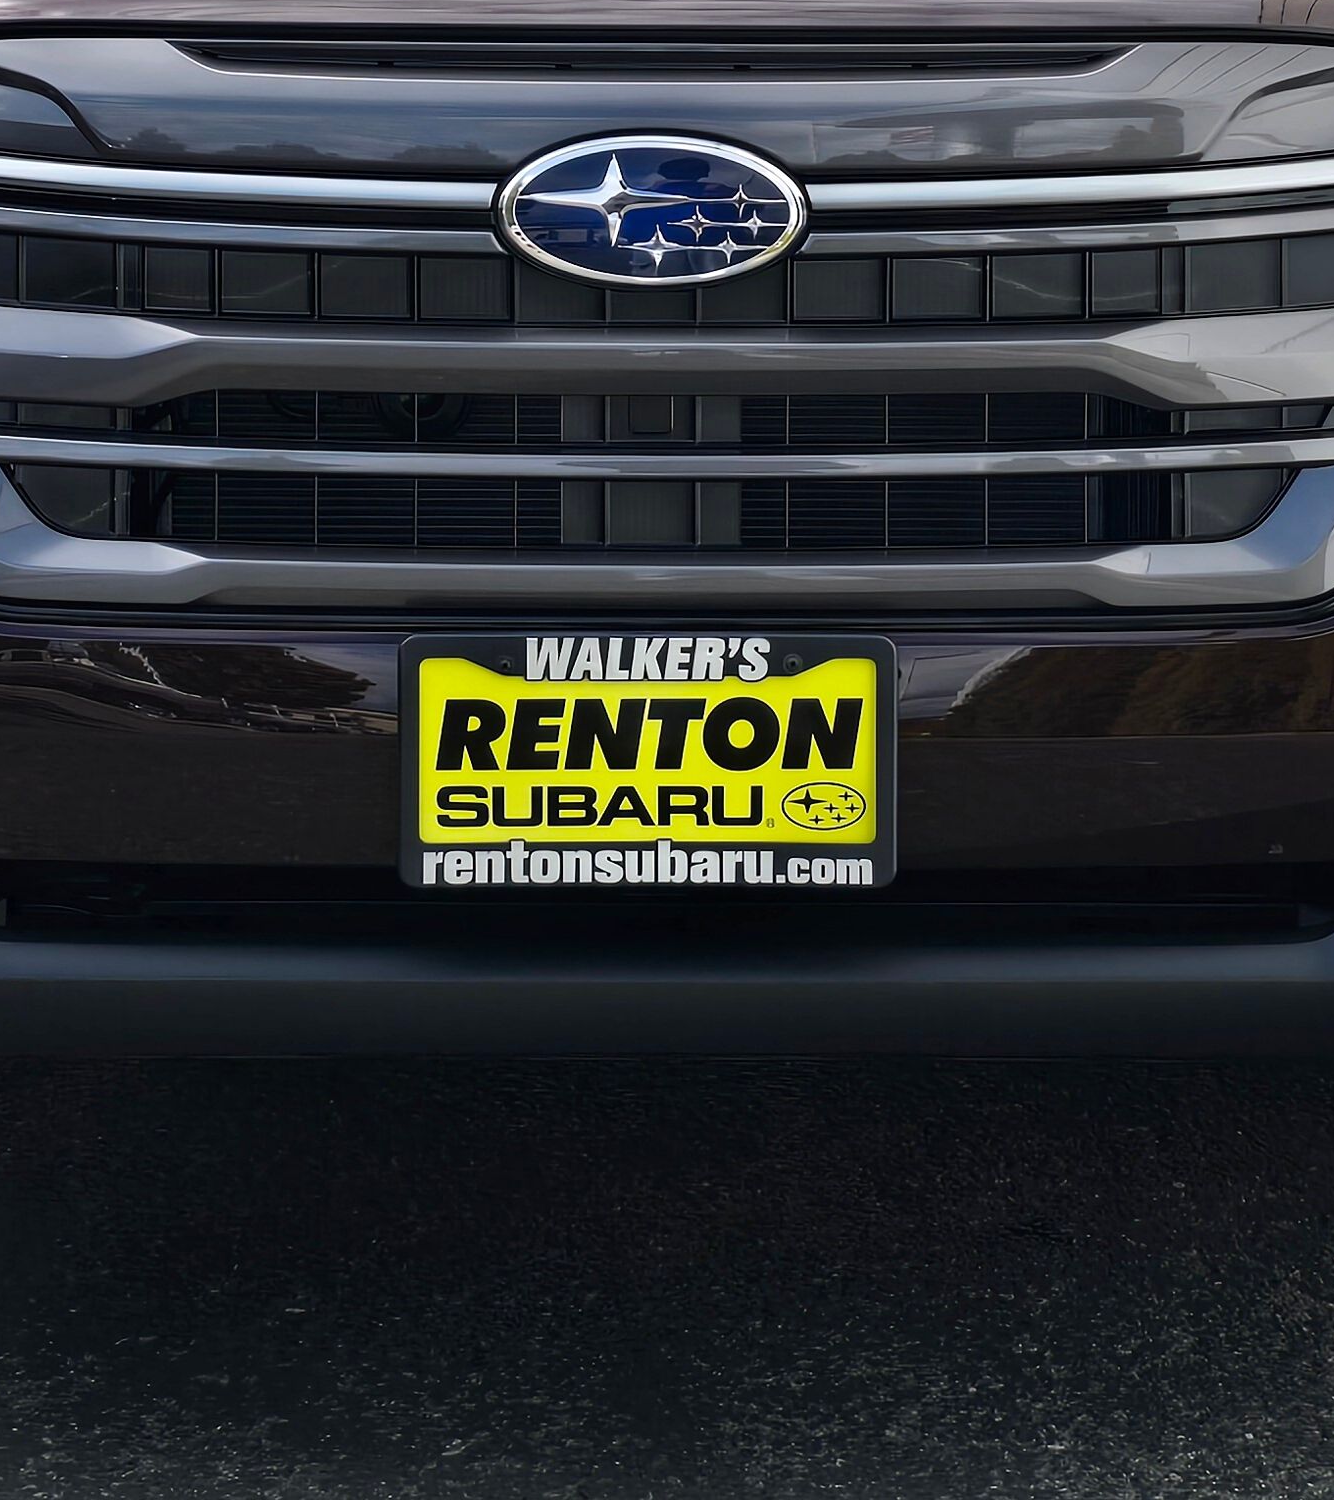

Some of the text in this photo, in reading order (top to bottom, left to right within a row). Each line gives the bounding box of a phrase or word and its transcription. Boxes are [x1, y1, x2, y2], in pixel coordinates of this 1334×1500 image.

[526, 636, 771, 682] WALKER'S
[435, 697, 864, 771] RENTON
[437, 785, 764, 827] SUBARU
[423, 839, 874, 886] rentonsubaru.com
